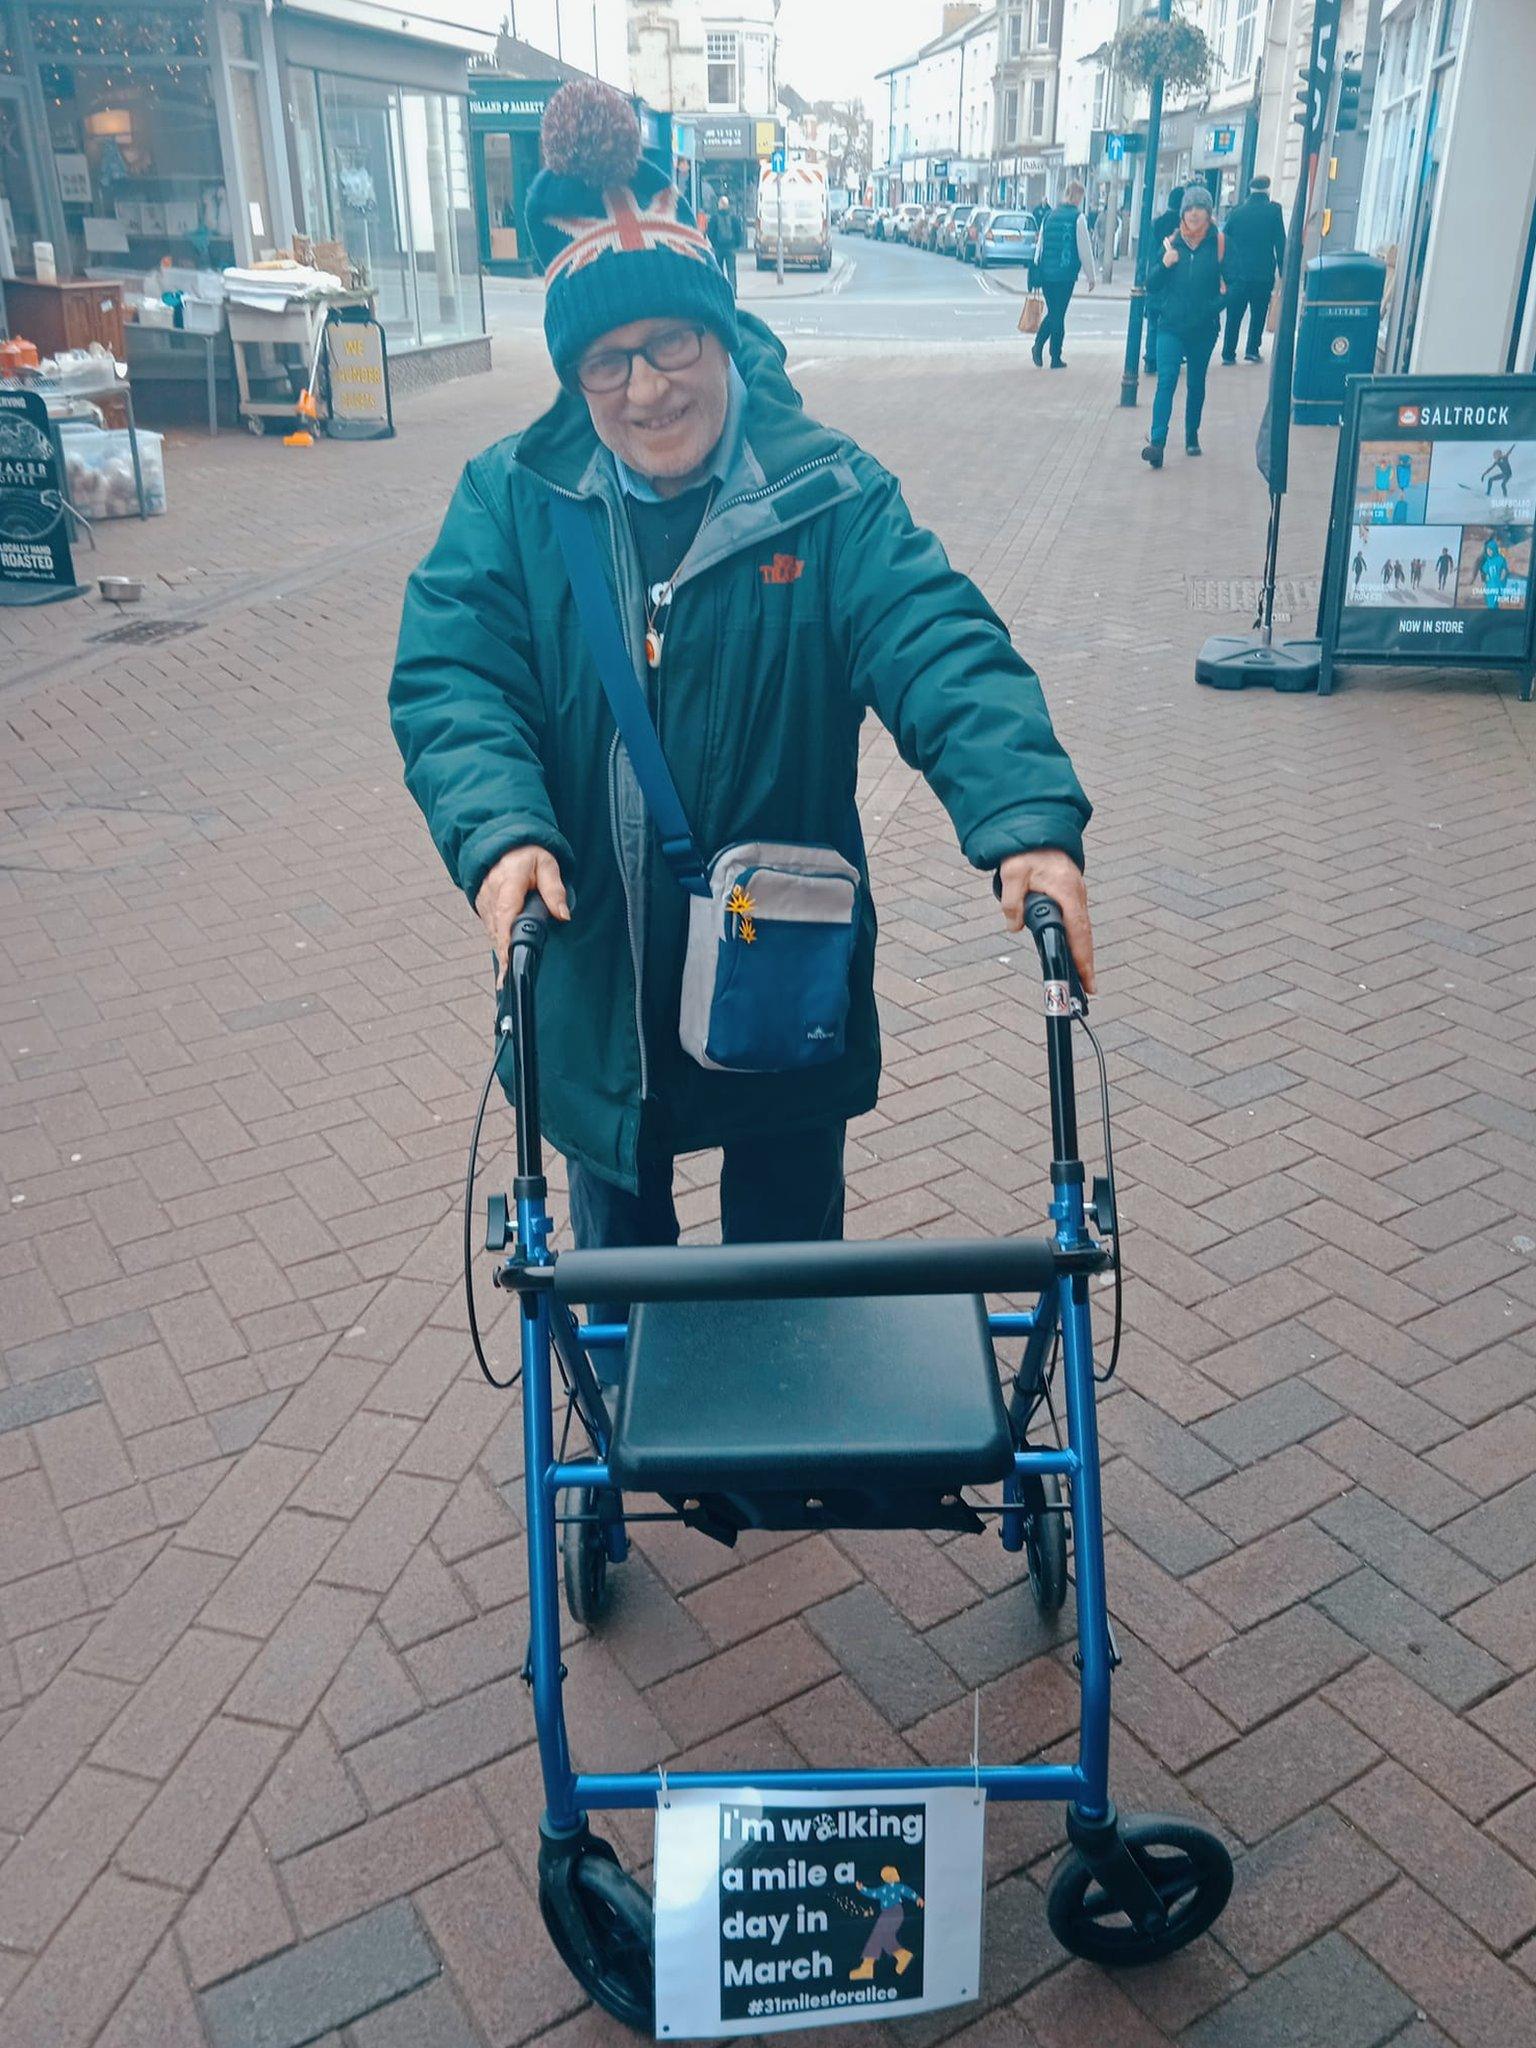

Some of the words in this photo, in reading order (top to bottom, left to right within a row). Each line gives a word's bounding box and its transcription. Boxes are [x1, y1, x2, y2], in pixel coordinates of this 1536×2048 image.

[1328, 308, 1360, 316] LITTER
[1420, 406, 1509, 426] SALTROCK
[1, 553, 54, 570] ROASTED
[1399, 620, 1421, 633] NOW
[1423, 620, 1432, 633] IN
[1435, 620, 1464, 633] STORE
[723, 1808, 775, 1842] I'm
[782, 1807, 923, 1845] walking
[722, 1867, 744, 1891] a
[752, 1858, 827, 1891] mile
[834, 1861, 856, 1884] a
[722, 1910, 790, 1946] day
[796, 1904, 828, 1934] in
[723, 1950, 833, 1987] March
[748, 1985, 898, 2017] #31milesforalice
